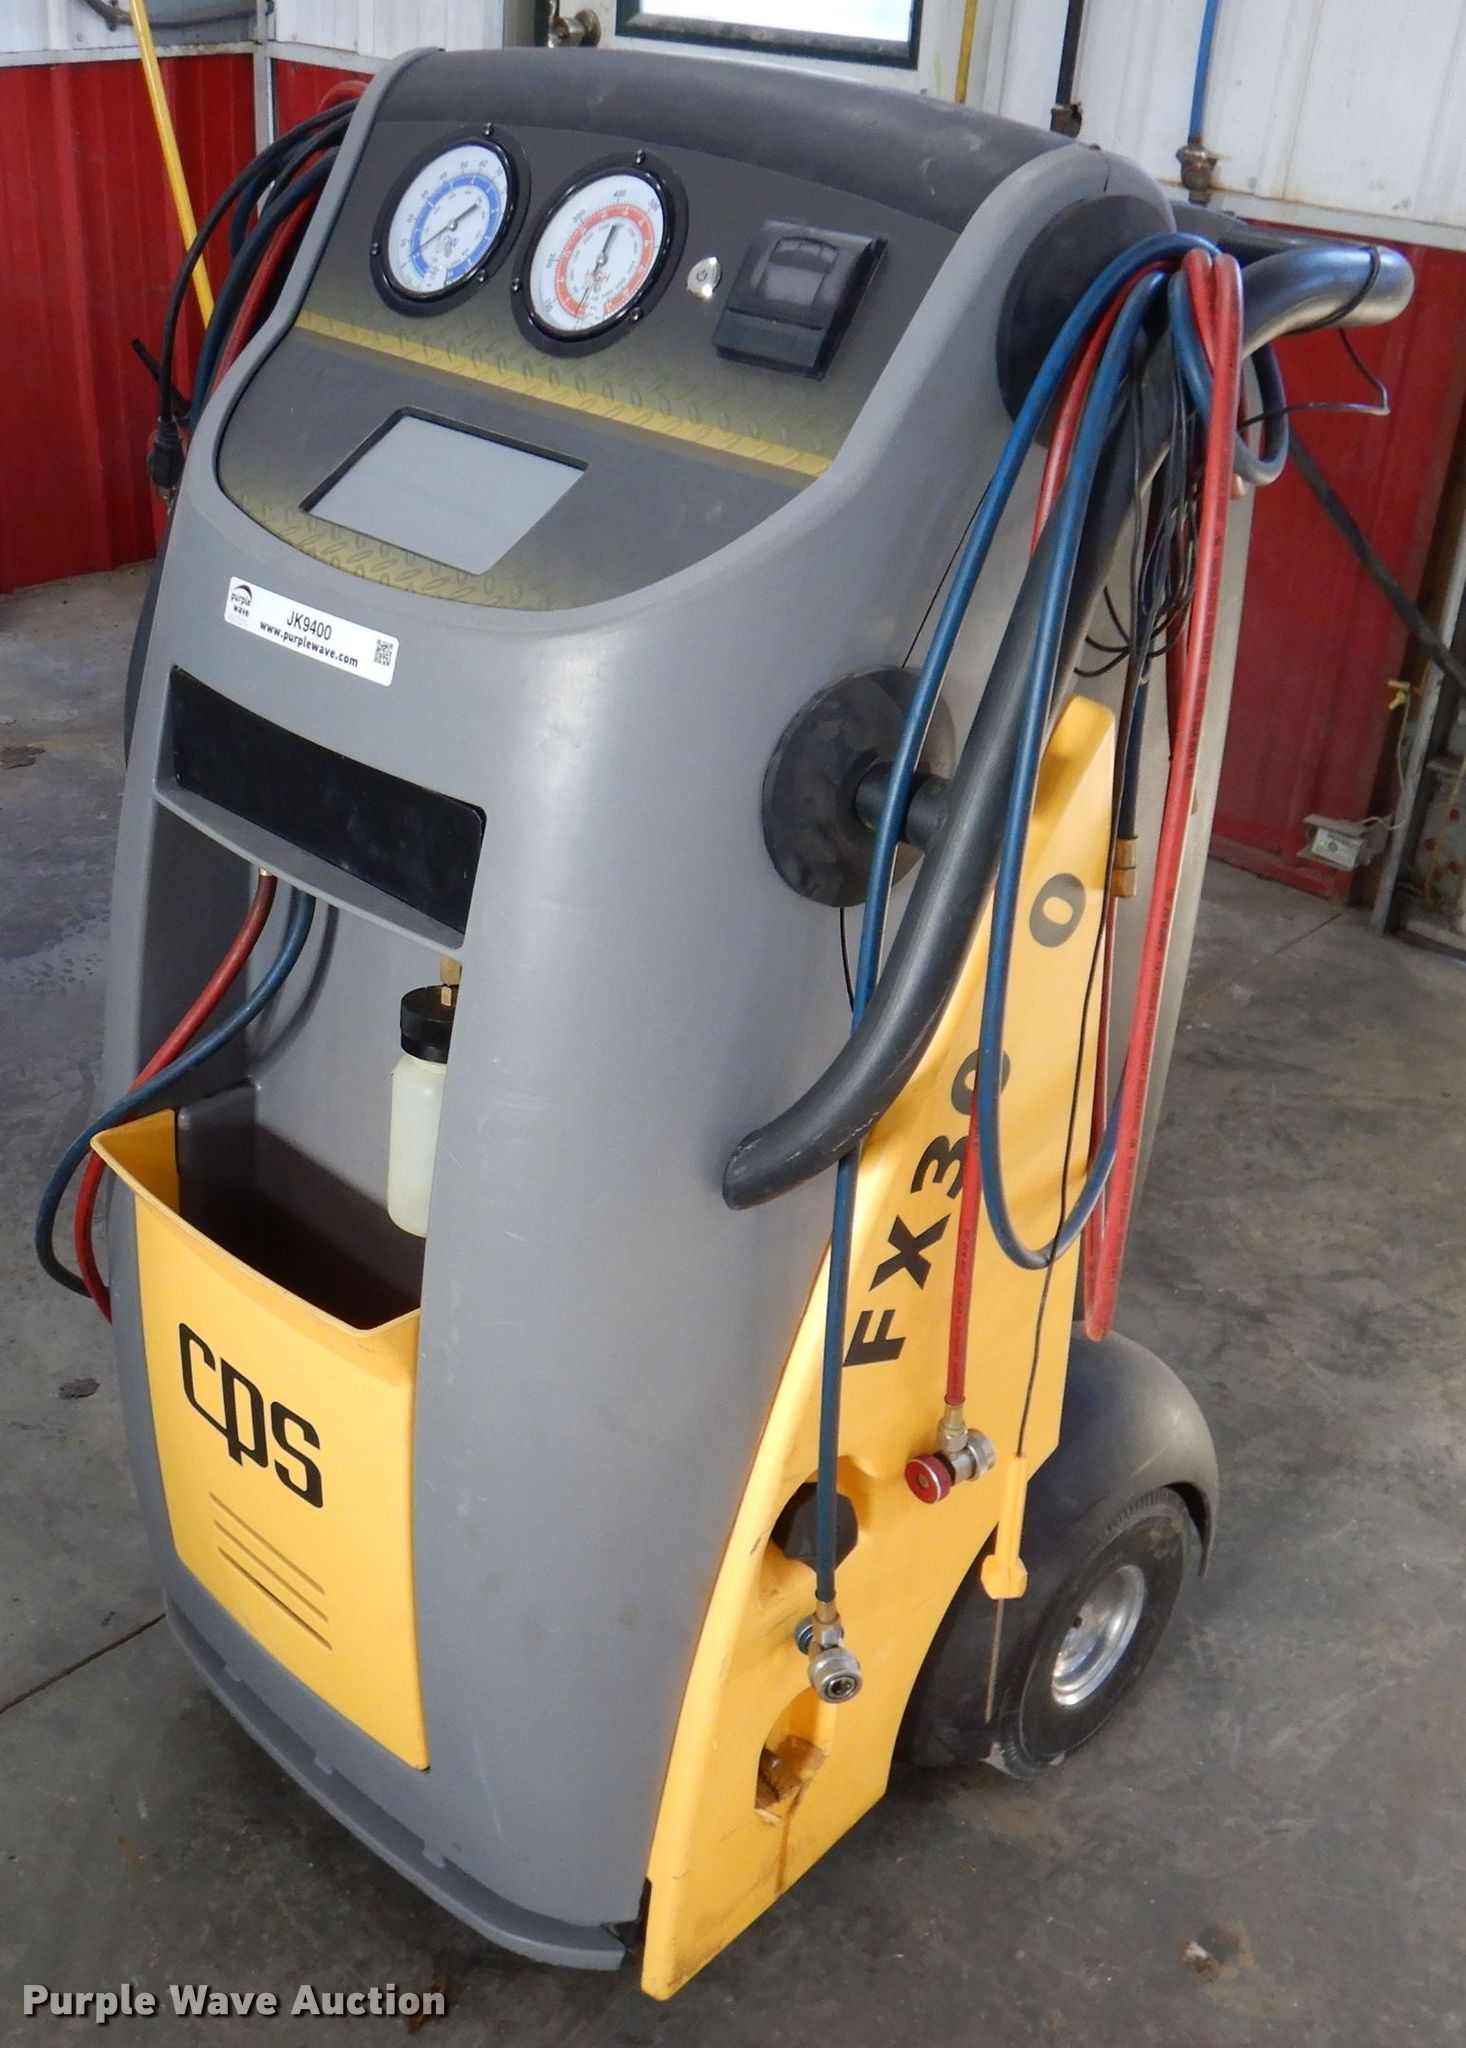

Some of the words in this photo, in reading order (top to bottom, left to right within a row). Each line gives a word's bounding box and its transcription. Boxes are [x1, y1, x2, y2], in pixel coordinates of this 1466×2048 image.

[231, 591, 251, 607] purple
[233, 605, 249, 617] wave
[286, 611, 332, 640] JK9400
[260, 621, 358, 667] www.purplewave.com
